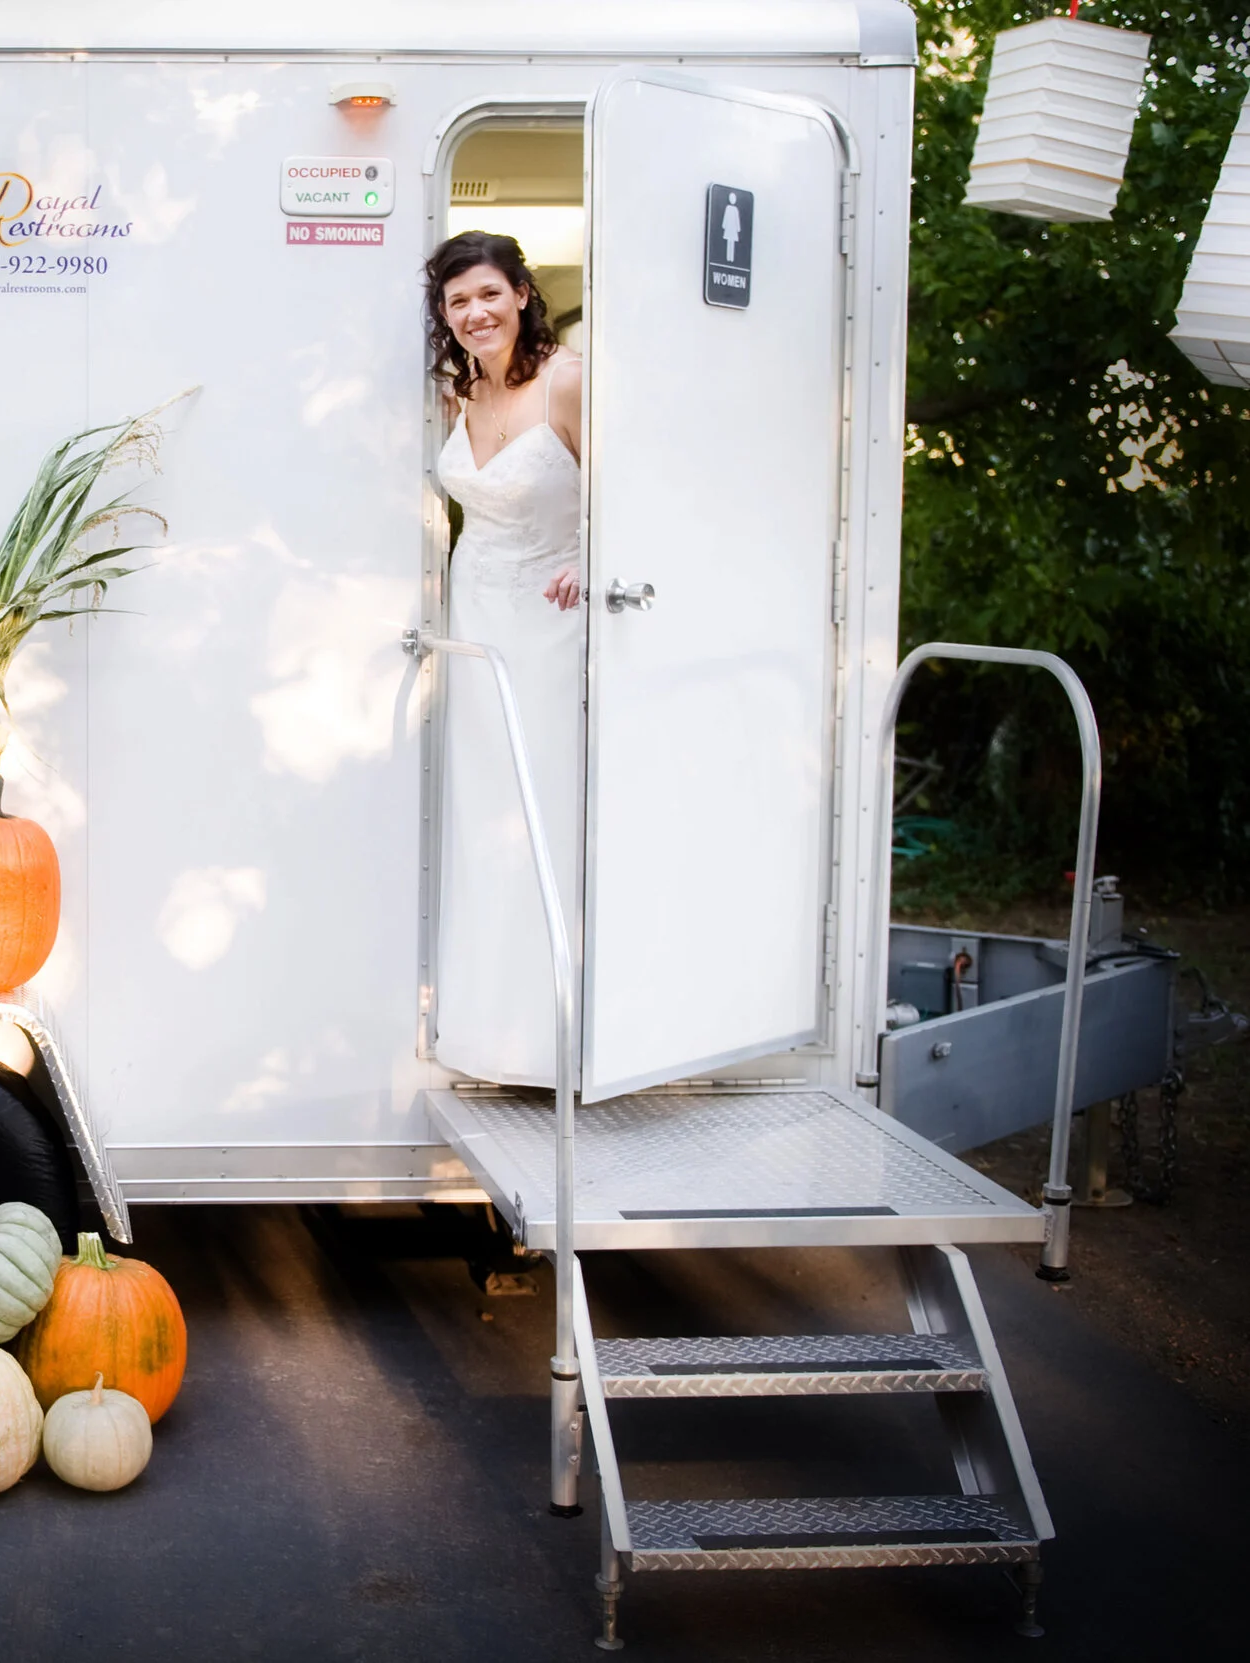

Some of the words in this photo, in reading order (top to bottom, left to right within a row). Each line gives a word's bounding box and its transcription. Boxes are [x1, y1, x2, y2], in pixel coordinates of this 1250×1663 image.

[287, 167, 362, 178] OCCUPIED
[295, 192, 351, 203] VACANT
[289, 226, 310, 241] NO
[314, 226, 381, 242] SMOKING
[712, 271, 746, 289] WOMEN
